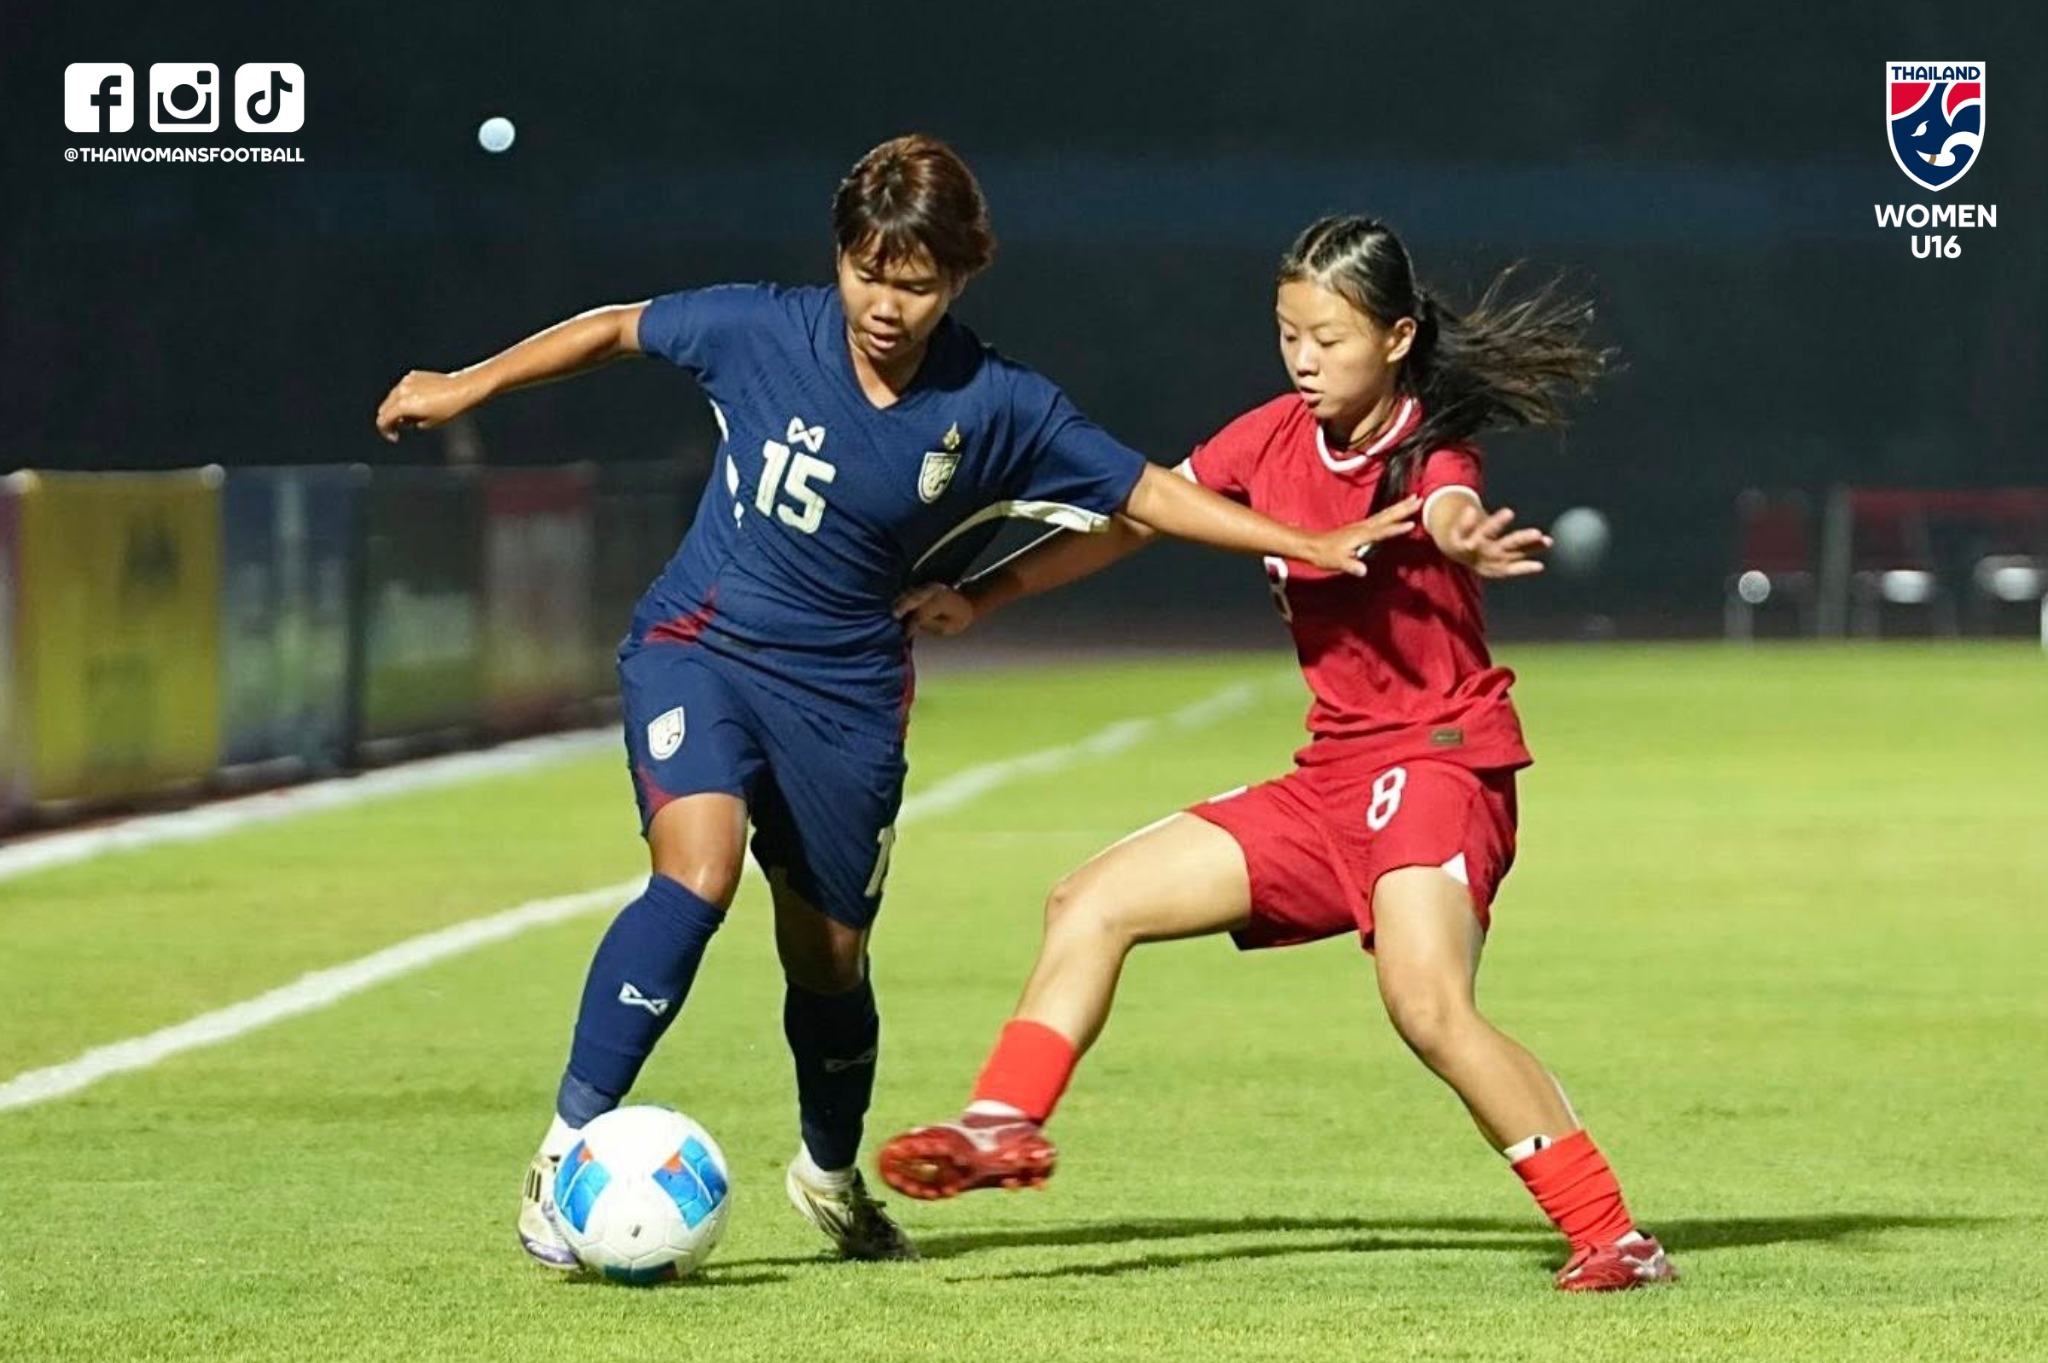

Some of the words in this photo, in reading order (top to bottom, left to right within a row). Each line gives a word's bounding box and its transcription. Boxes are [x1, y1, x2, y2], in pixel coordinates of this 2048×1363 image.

[755, 439, 836, 534] 15
[1366, 766, 1407, 831] 8
[864, 825, 896, 897] 1
